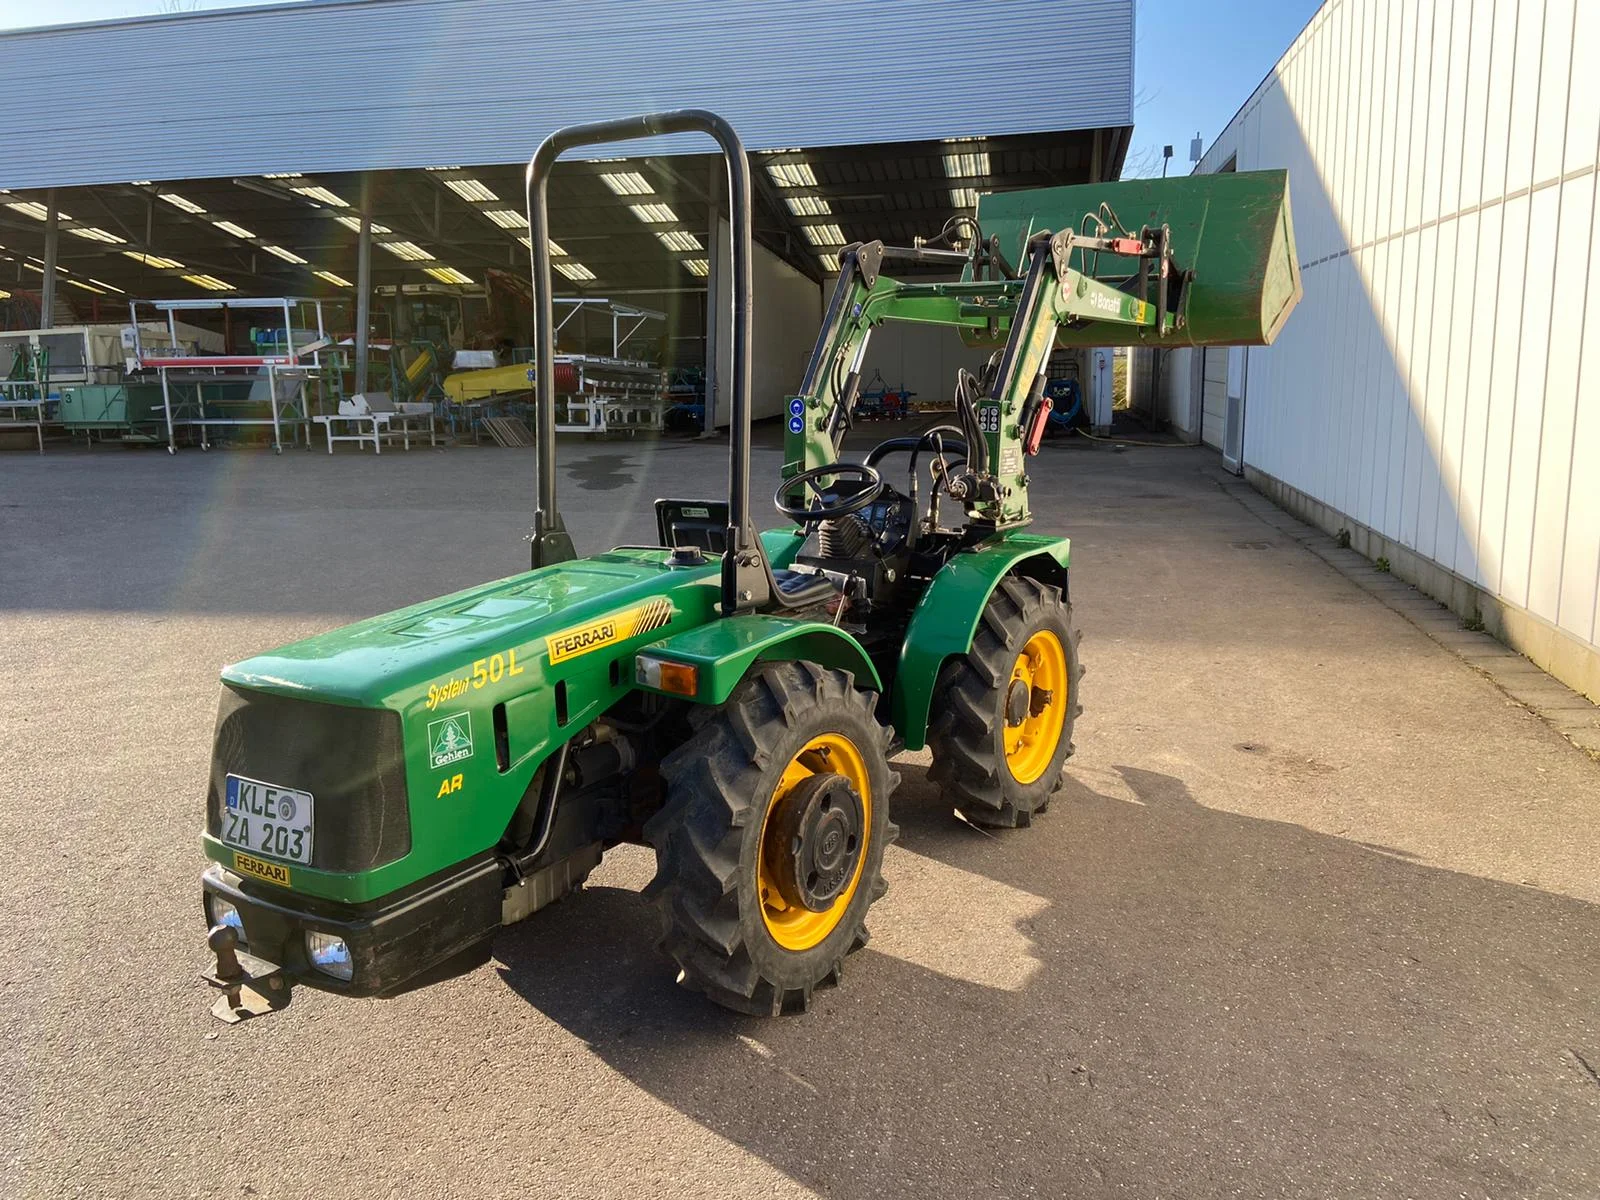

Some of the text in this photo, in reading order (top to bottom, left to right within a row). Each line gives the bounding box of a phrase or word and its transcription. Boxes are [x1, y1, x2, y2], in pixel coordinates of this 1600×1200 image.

[65, 393, 72, 404] 3
[555, 624, 614, 656] FERRARI
[425, 678, 470, 711] System
[435, 748, 469, 765] Gehlen
[239, 782, 278, 819] KLE
[437, 773, 464, 799] AR
[225, 814, 304, 859] ZA 203
[236, 855, 287, 882] FERRARI
